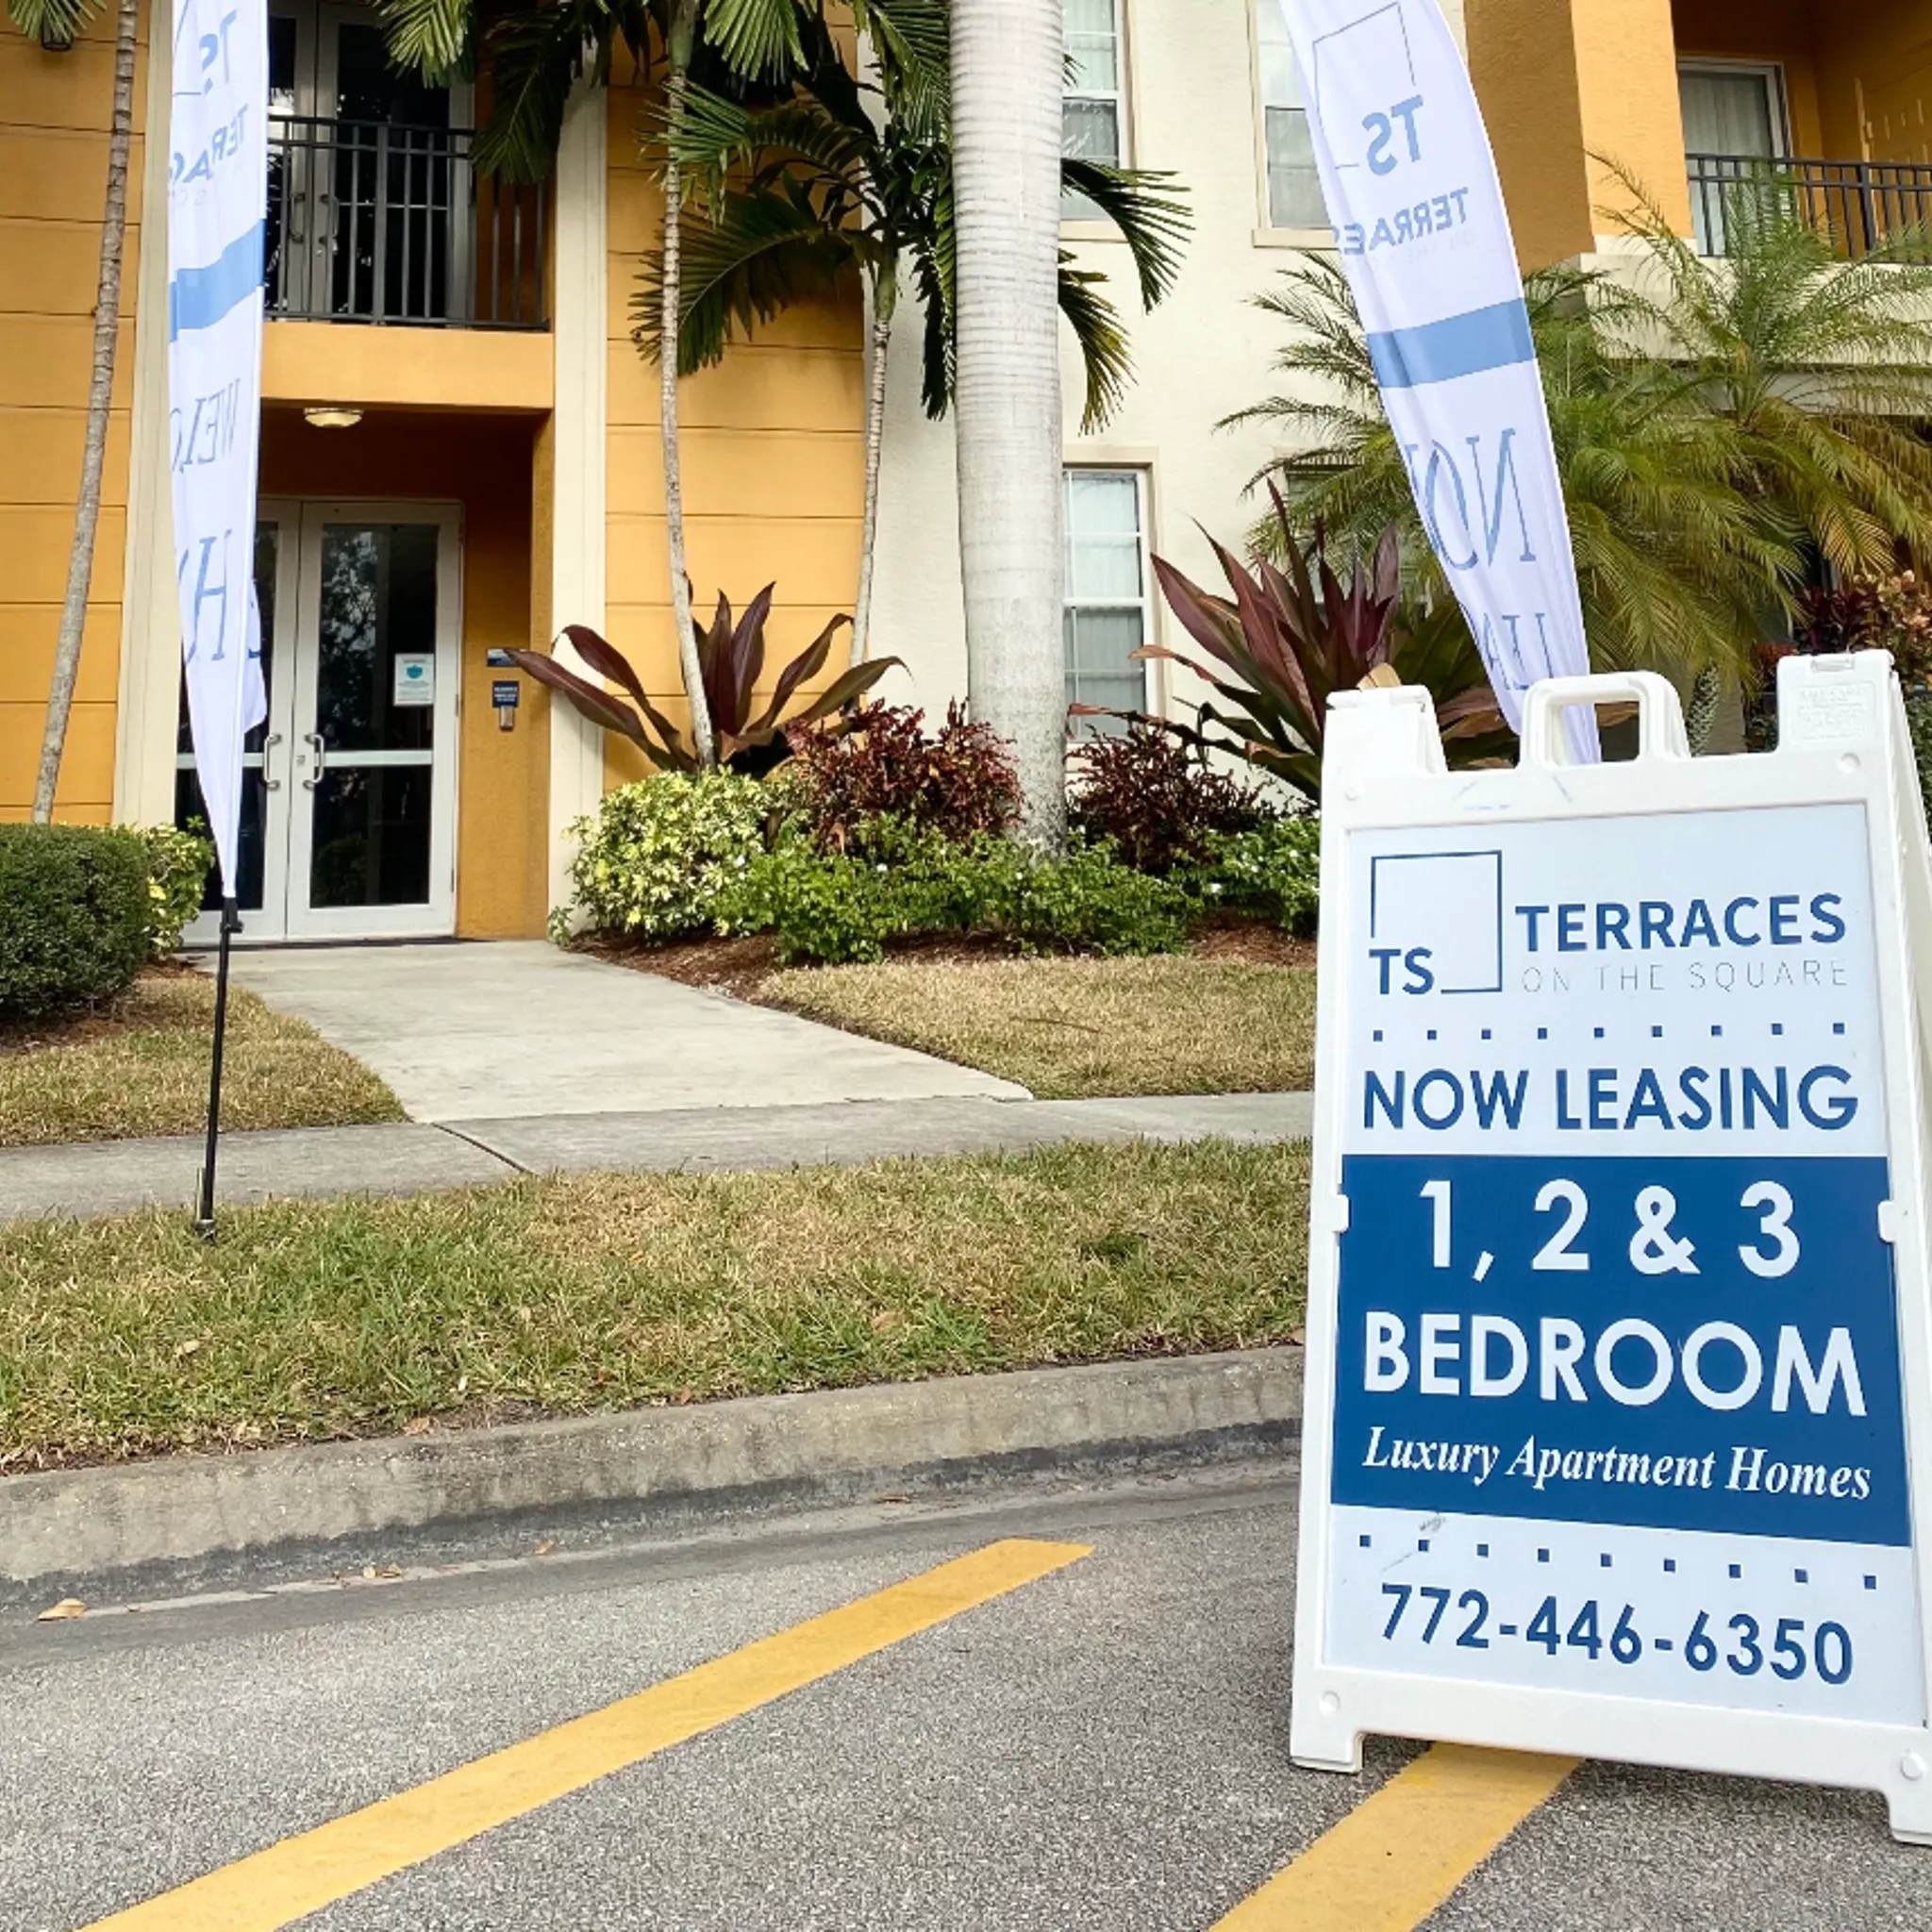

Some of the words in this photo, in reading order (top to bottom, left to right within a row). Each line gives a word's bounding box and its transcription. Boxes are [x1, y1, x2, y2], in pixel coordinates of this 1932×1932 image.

[1515, 893, 1846, 952] TERRACES
[1369, 947, 1434, 995] TS
[1522, 966, 1570, 992] ON
[1595, 964, 1665, 991] THE
[1688, 959, 1848, 993] SQUARE
[1364, 1069, 1529, 1130] NOW
[1556, 1065, 1858, 1131] LEASING
[1420, 1180, 1494, 1282] 1,
[1532, 1178, 1590, 1271] 2
[1629, 1185, 1701, 1274] &
[1739, 1180, 1800, 1277] 3
[1364, 1311, 1867, 1416] BEDROOM
[1362, 1426, 1500, 1486] Luxury
[1506, 1435, 1716, 1491] Apartment
[1725, 1446, 1872, 1500] Homes
[1381, 1583, 1853, 1685] 772-446-6350
